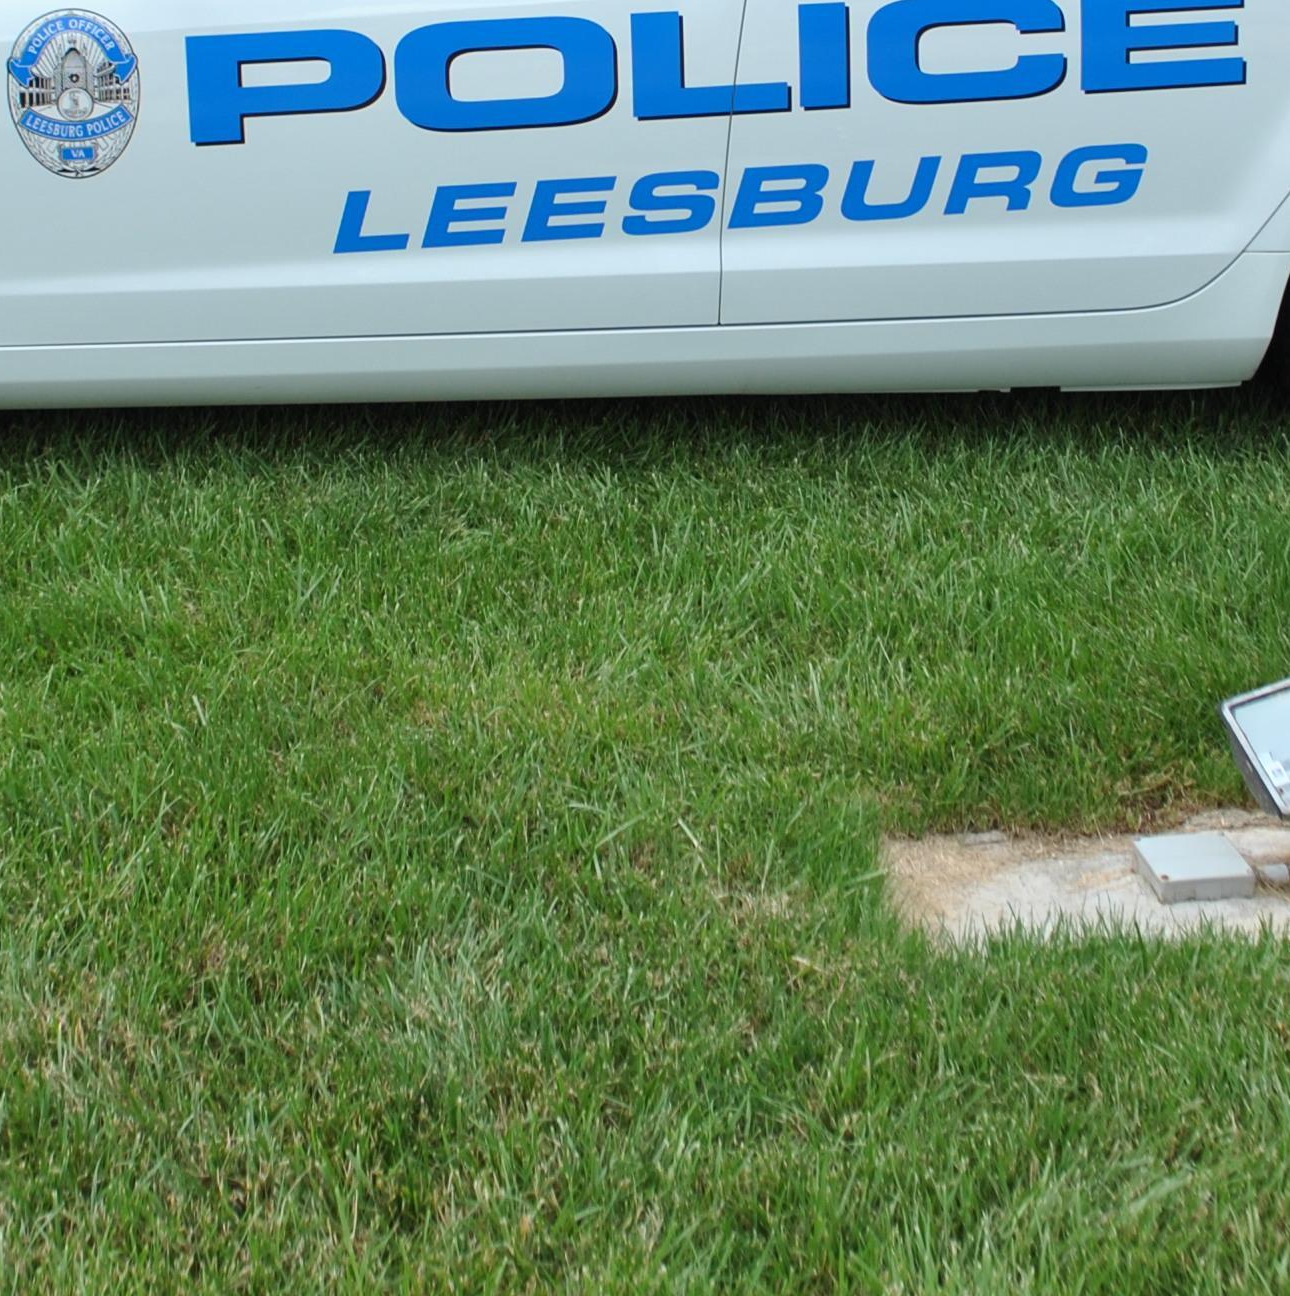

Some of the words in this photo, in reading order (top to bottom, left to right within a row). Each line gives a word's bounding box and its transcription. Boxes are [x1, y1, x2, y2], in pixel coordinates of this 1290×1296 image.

[28, 21, 65, 54] POLICE
[68, 19, 115, 51] OFFICER
[26, 114, 84, 137] LEESBURG
[86, 110, 126, 136] POLICE
[71, 149, 85, 158] VA
[332, 143, 1148, 254] LEESBURG
